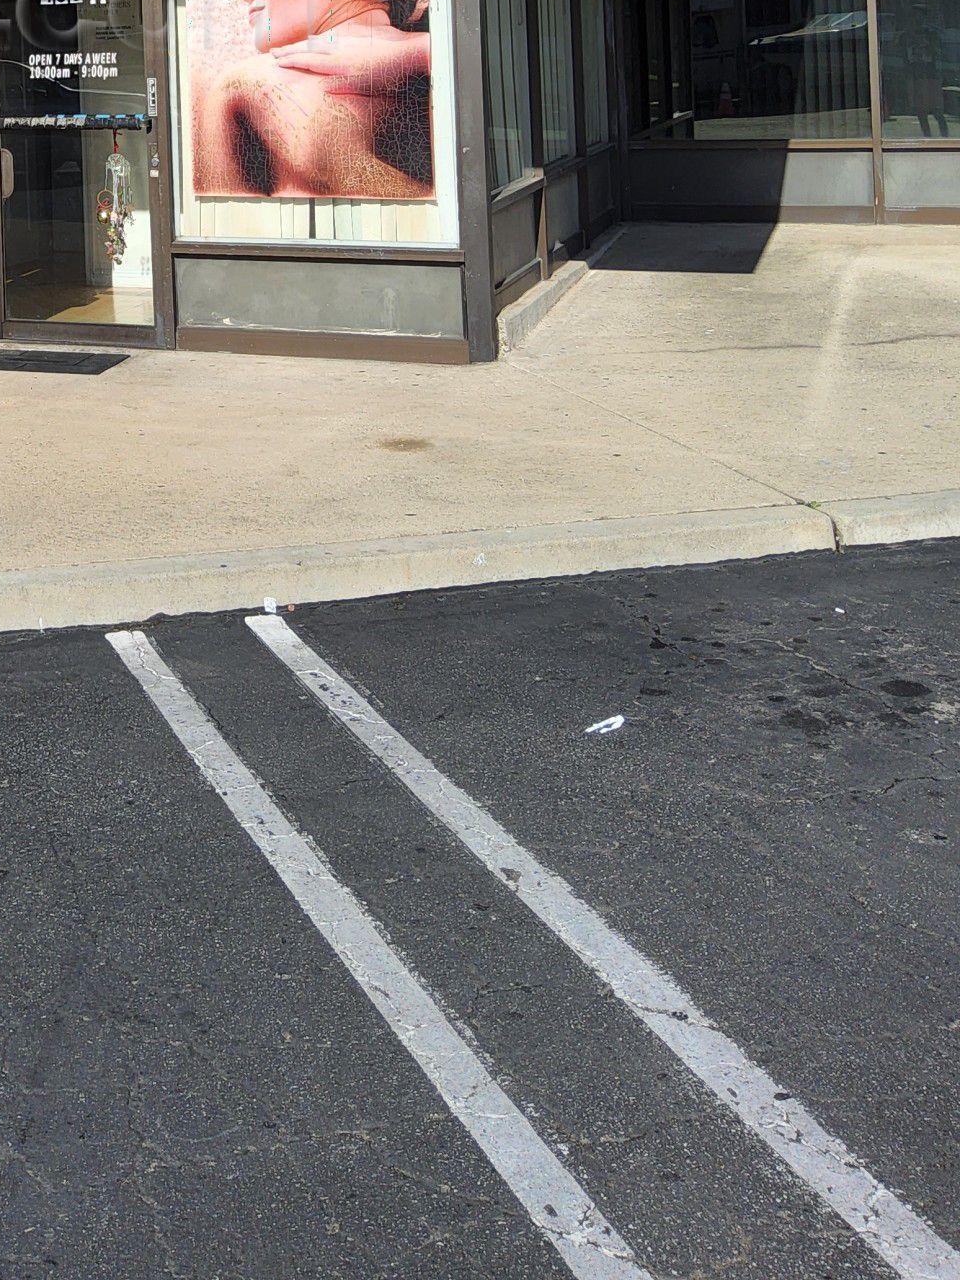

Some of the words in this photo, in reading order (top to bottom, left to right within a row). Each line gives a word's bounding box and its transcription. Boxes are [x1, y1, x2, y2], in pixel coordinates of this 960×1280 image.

[29, 54, 52, 65] OPEN
[55, 53, 61, 65] 7
[64, 53, 83, 65] DAYS
[85, 53, 91, 64] A
[92, 52, 117, 64] WEEK
[29, 66, 71, 79] 10:00am
[81, 65, 118, 80] 9:00pm
